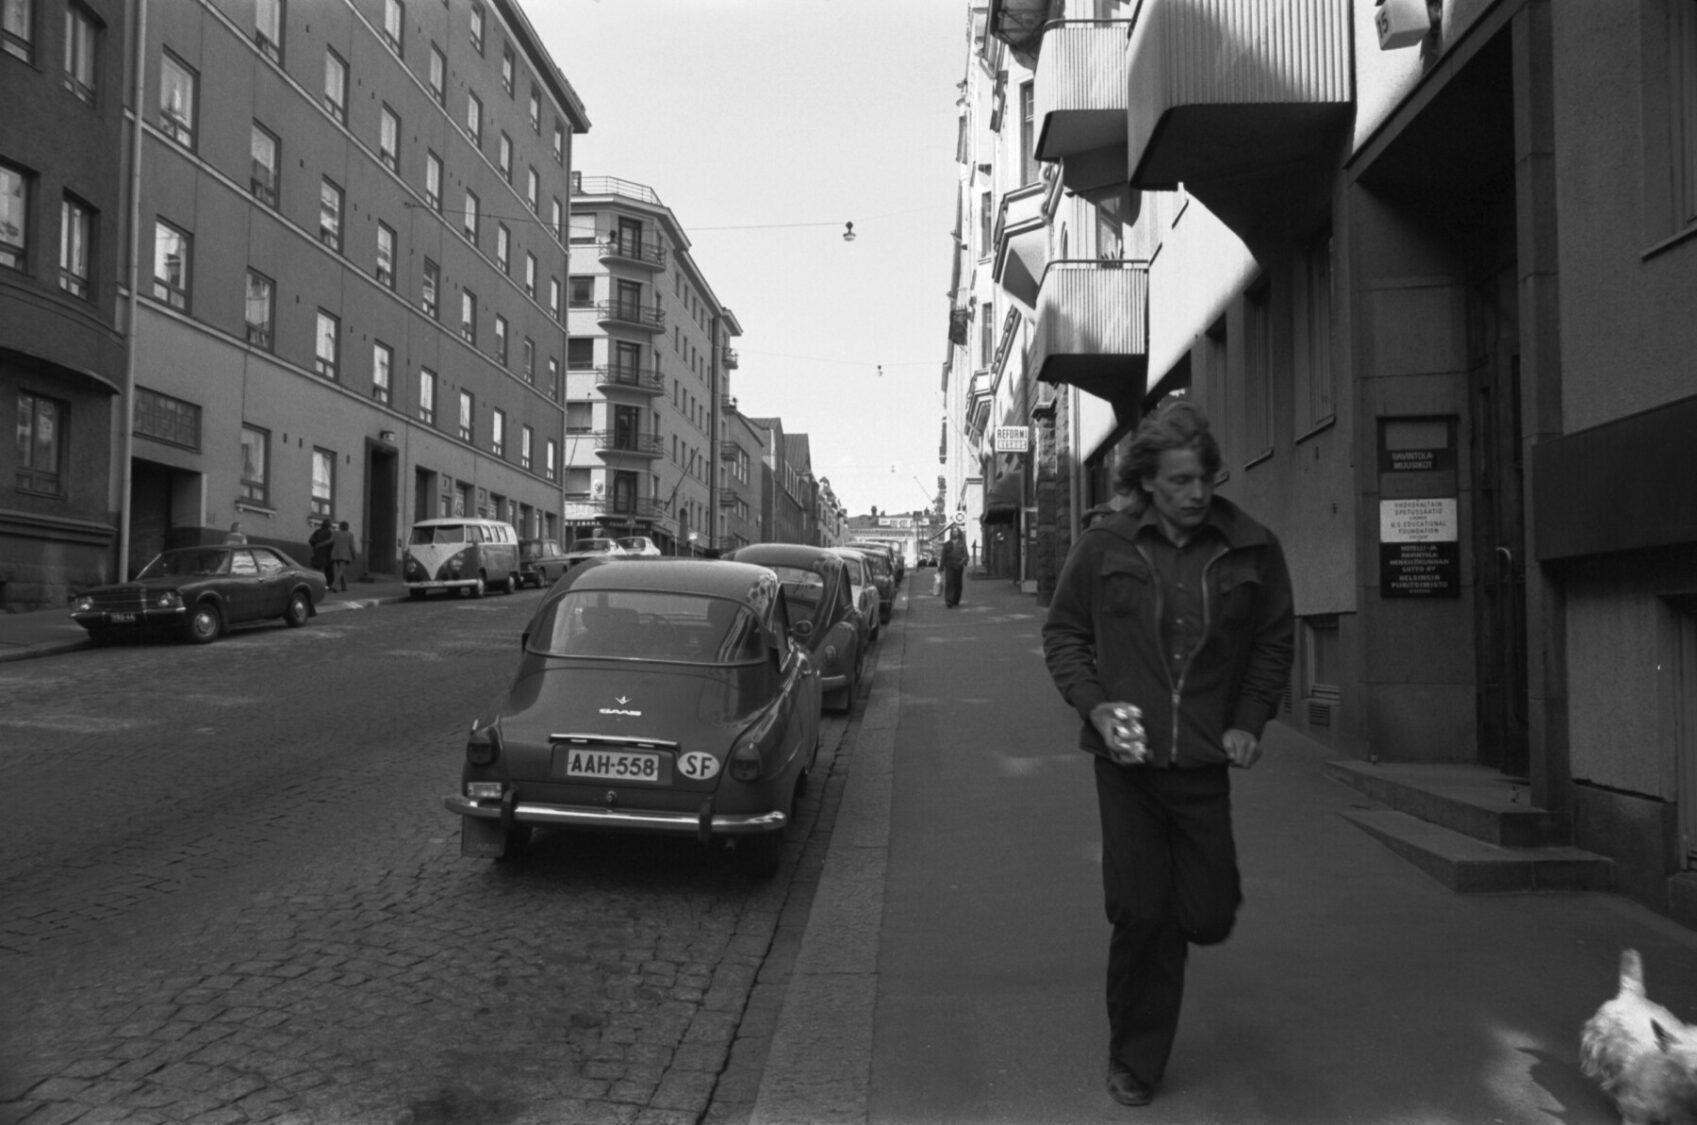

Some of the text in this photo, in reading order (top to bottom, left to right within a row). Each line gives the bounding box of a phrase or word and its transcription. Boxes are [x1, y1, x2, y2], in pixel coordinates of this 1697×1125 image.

[1377, 11, 1389, 38] 15
[570, 752, 655, 778] AAH-558
[685, 754, 713, 777] SF
